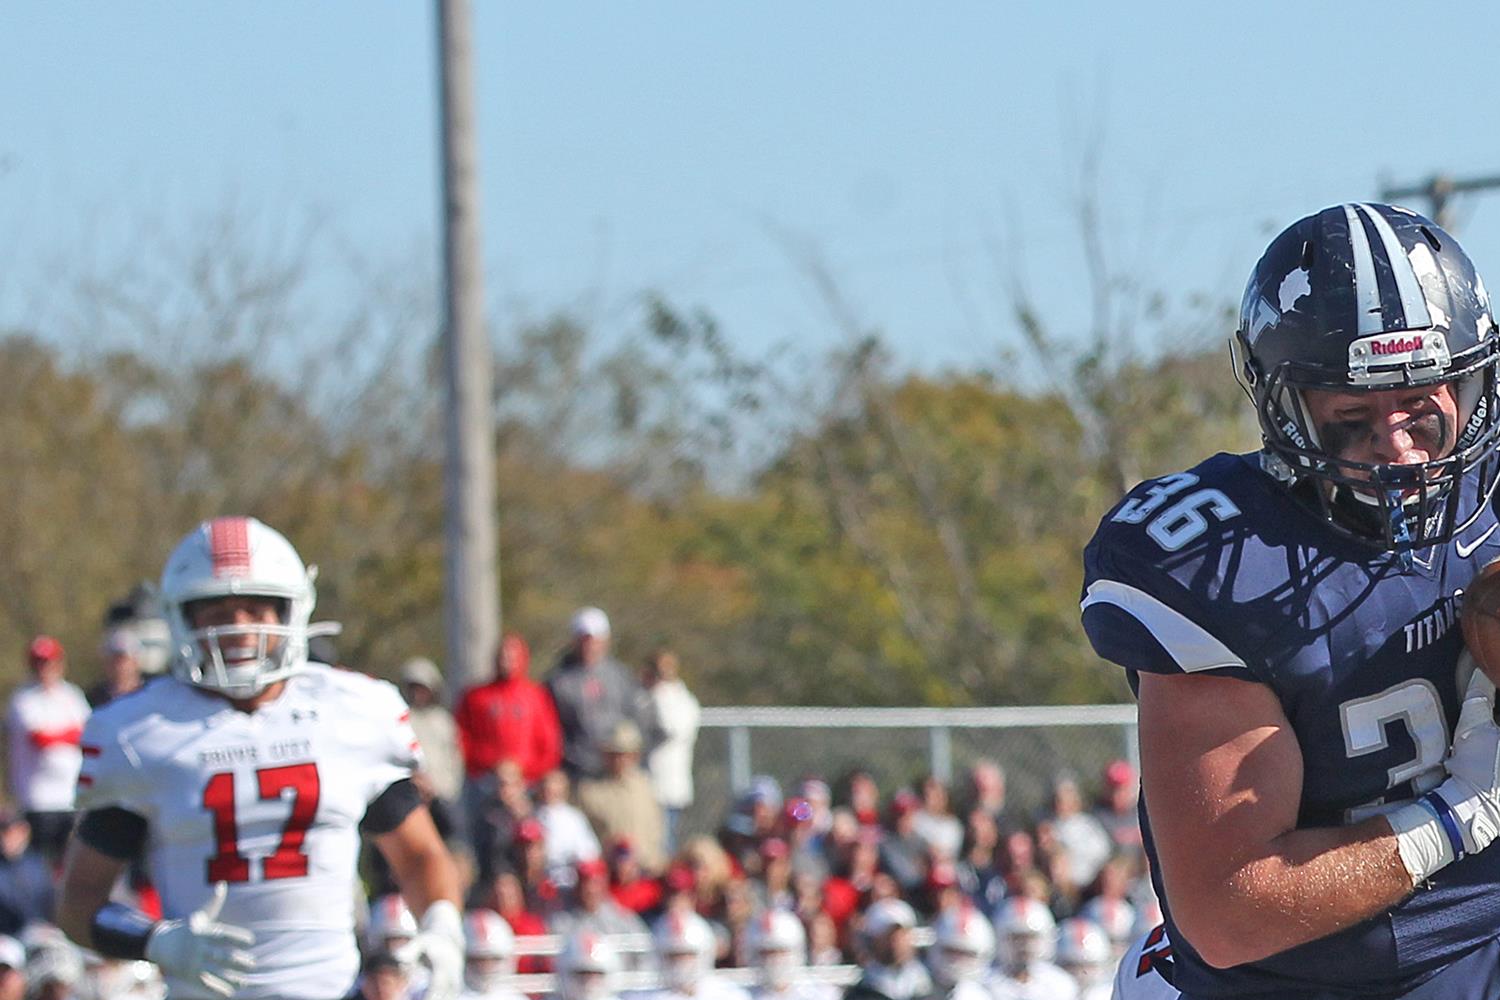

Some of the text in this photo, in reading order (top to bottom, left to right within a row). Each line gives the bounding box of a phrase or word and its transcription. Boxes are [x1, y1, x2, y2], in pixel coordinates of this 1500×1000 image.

[1370, 336, 1424, 356] Riddell
[1110, 471, 1242, 552] 36
[203, 761, 321, 884] 17
